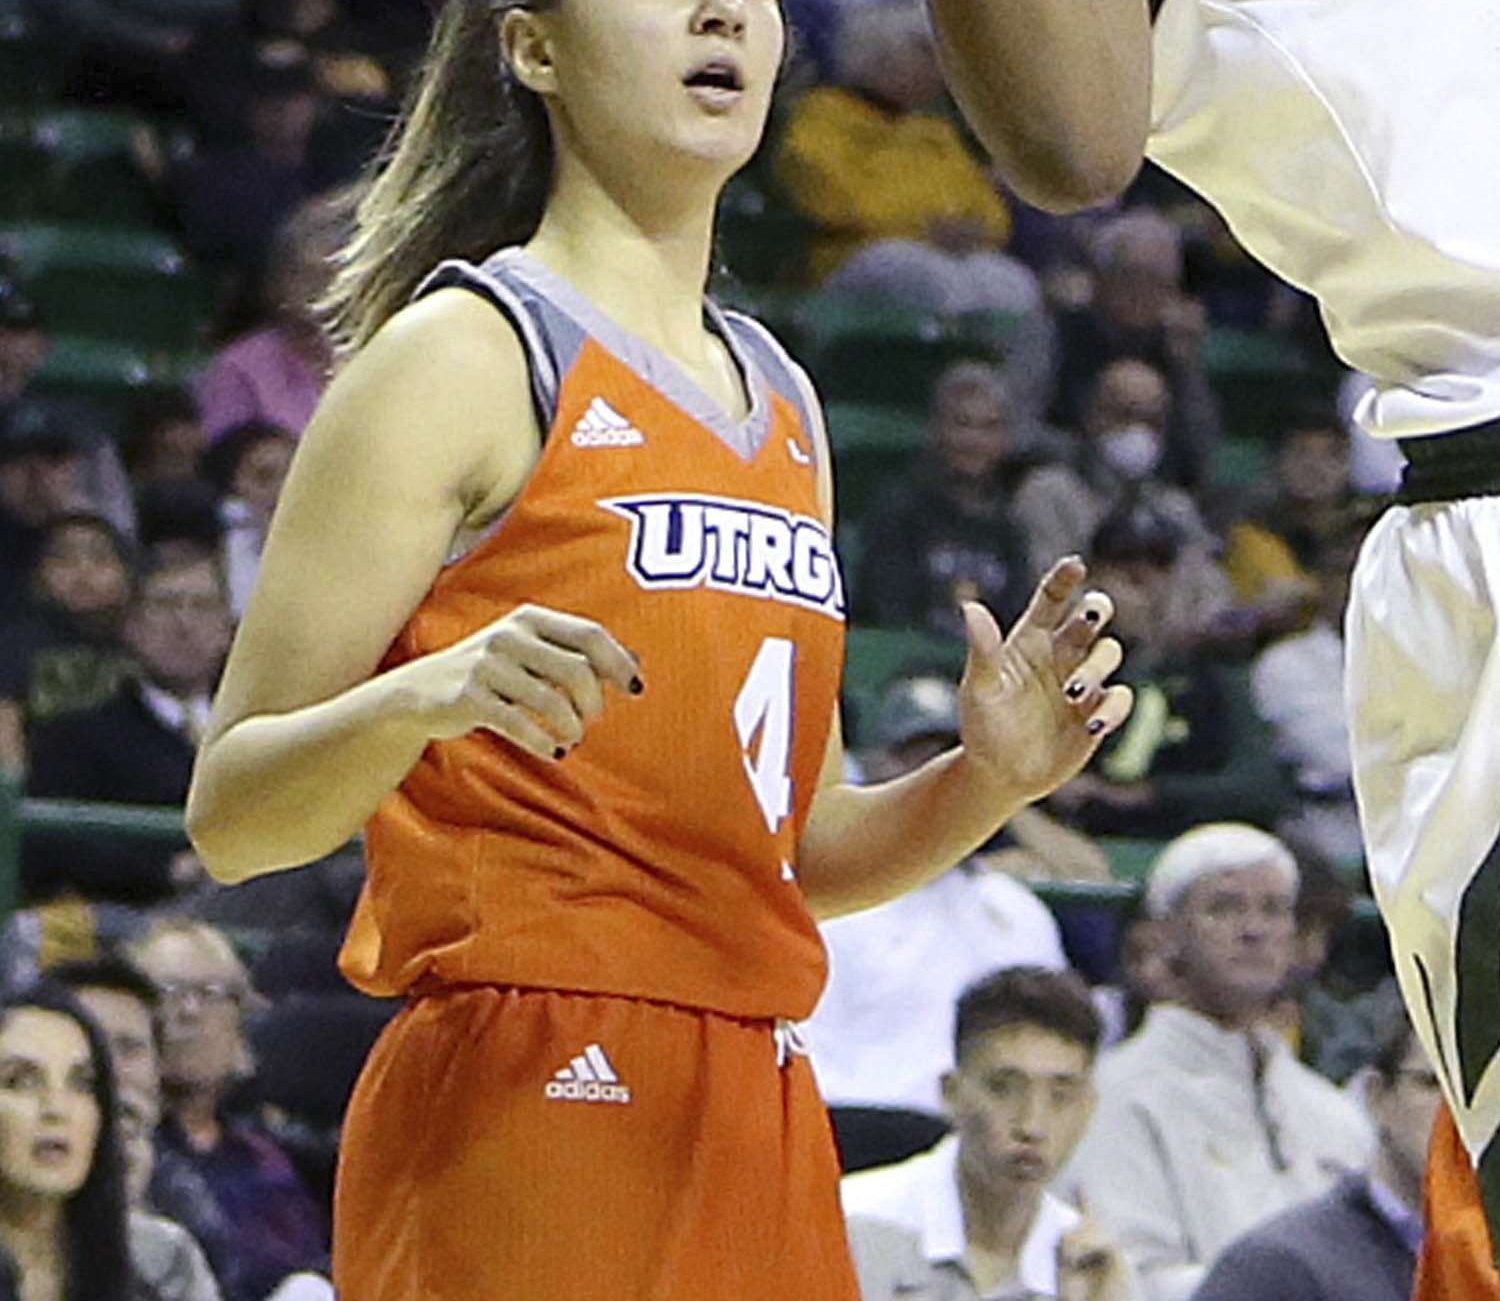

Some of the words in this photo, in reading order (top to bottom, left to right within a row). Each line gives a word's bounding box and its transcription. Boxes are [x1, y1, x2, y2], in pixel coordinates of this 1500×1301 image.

[597, 493, 846, 620] UTRG
[733, 637, 797, 880] 4
[544, 1081, 631, 1104] adidas
